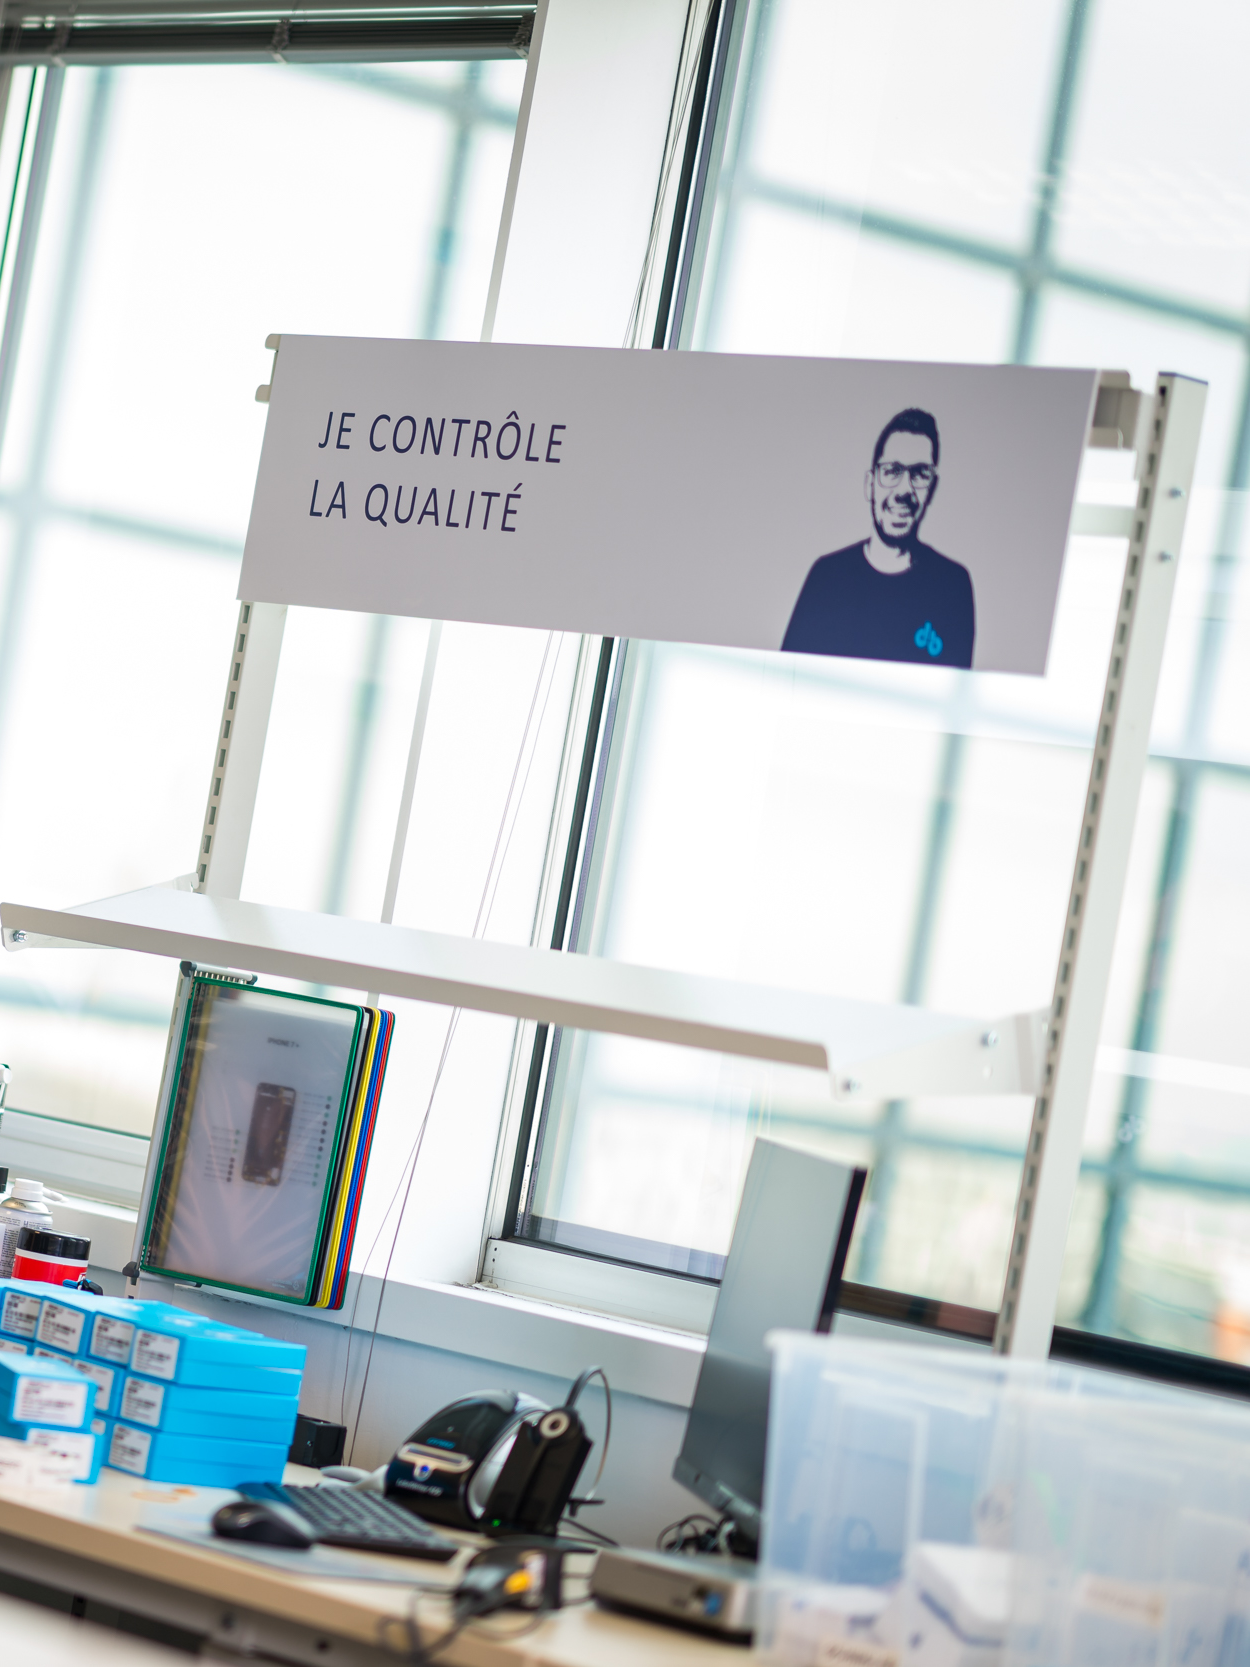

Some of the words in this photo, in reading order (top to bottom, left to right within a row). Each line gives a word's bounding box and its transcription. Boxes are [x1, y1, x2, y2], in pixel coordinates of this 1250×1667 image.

[318, 411, 356, 450] JE
[369, 410, 567, 463] CONTRÔLE
[309, 479, 347, 519] LA
[364, 482, 523, 532] QUALITÉ
